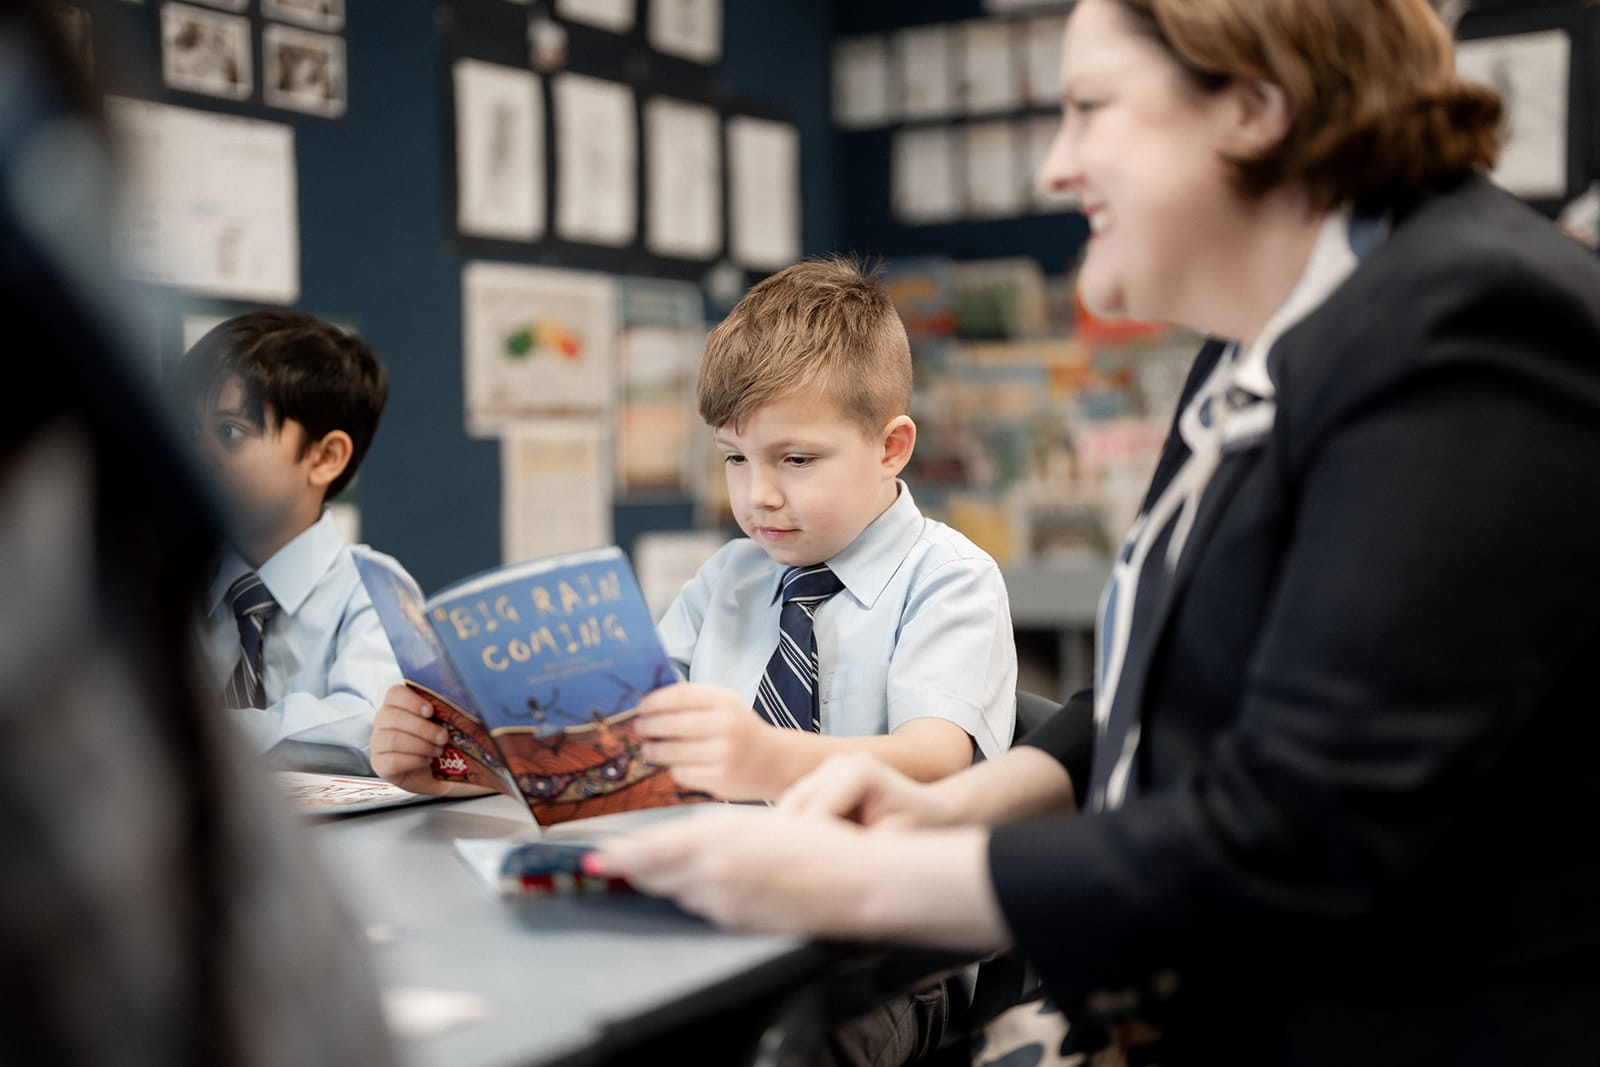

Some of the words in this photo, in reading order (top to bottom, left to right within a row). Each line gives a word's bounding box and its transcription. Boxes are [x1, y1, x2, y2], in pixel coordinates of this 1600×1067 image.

[450, 595, 520, 640] BIG
[531, 570, 620, 617] RAIN
[482, 613, 628, 671] COMING
